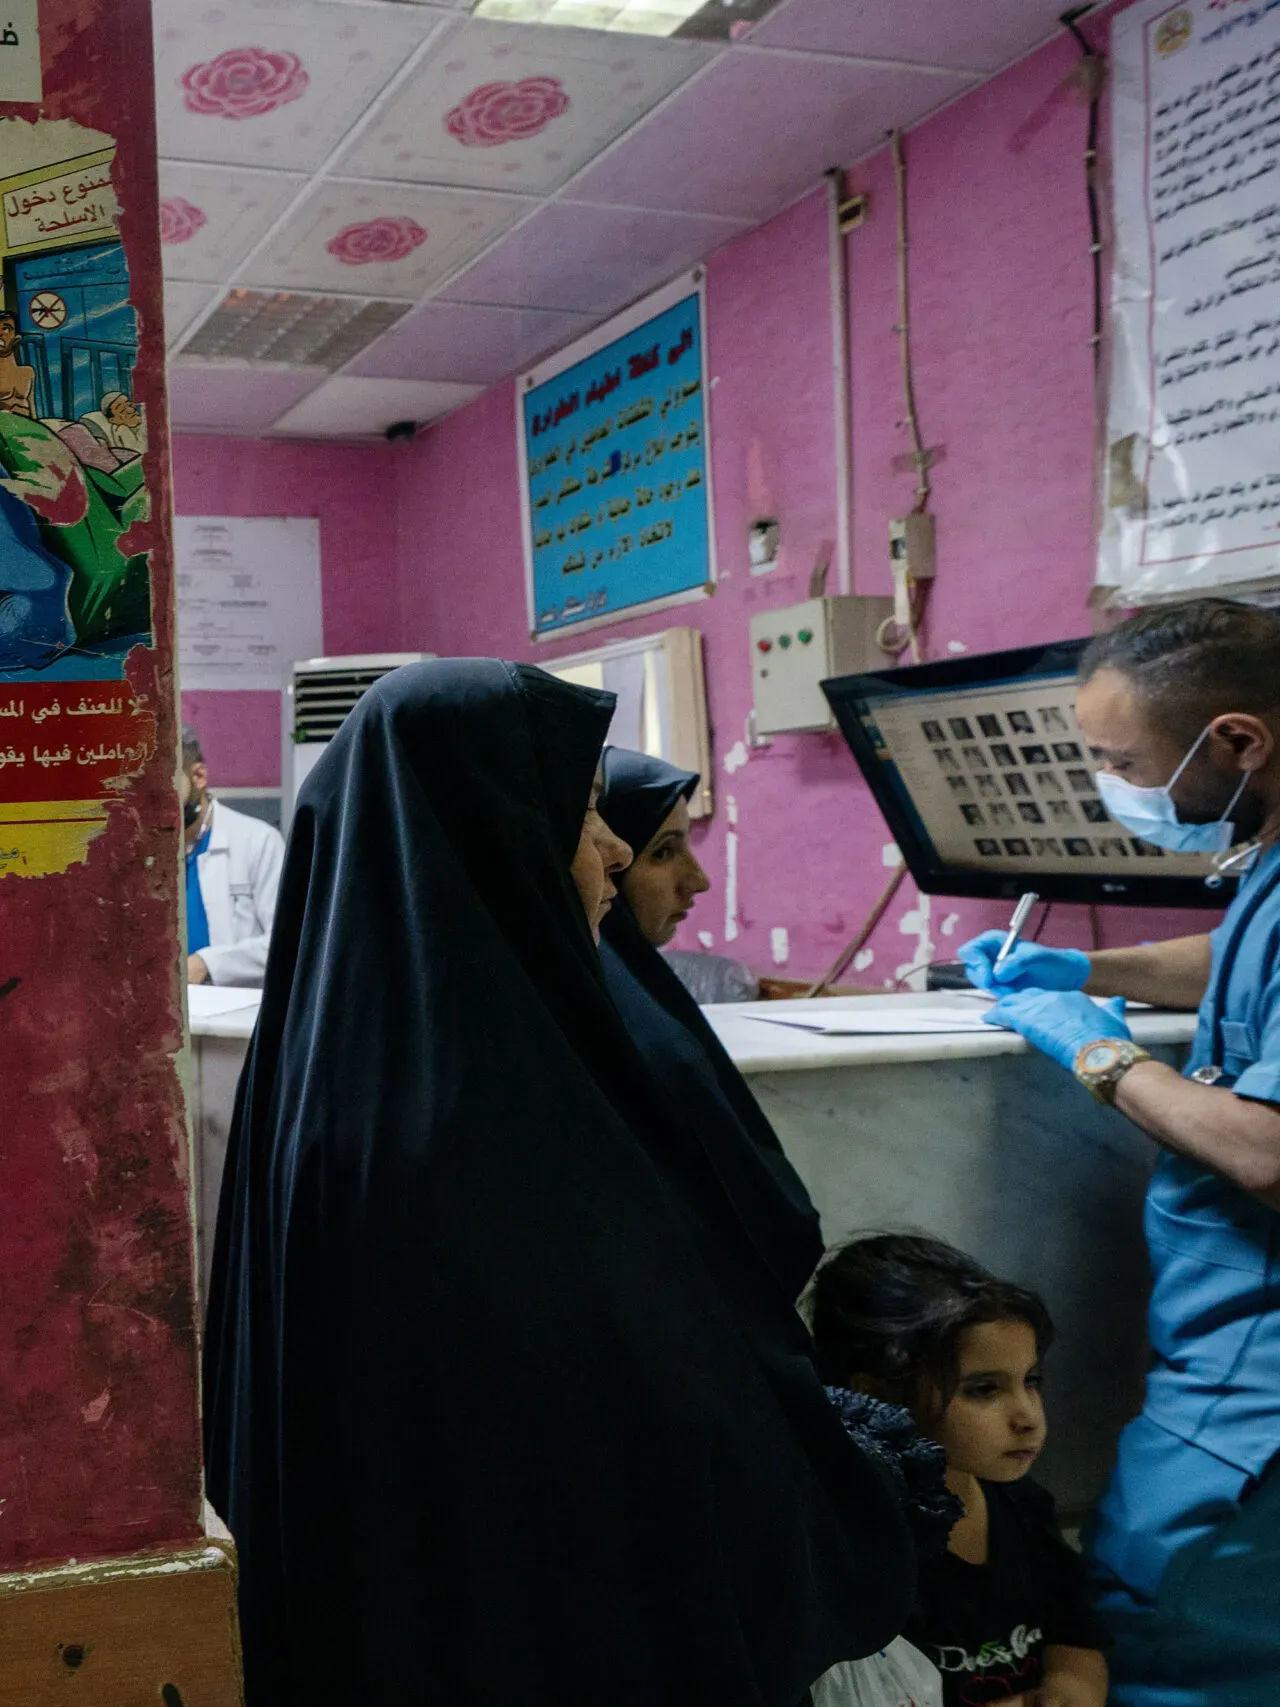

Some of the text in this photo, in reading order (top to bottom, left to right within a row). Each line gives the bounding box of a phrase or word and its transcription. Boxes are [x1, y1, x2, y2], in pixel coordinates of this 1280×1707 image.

[7, 190, 57, 217] دخول
[31, 697, 61, 724] في
[66, 697, 123, 716] للعنف
[32, 743, 72, 768] فيها
